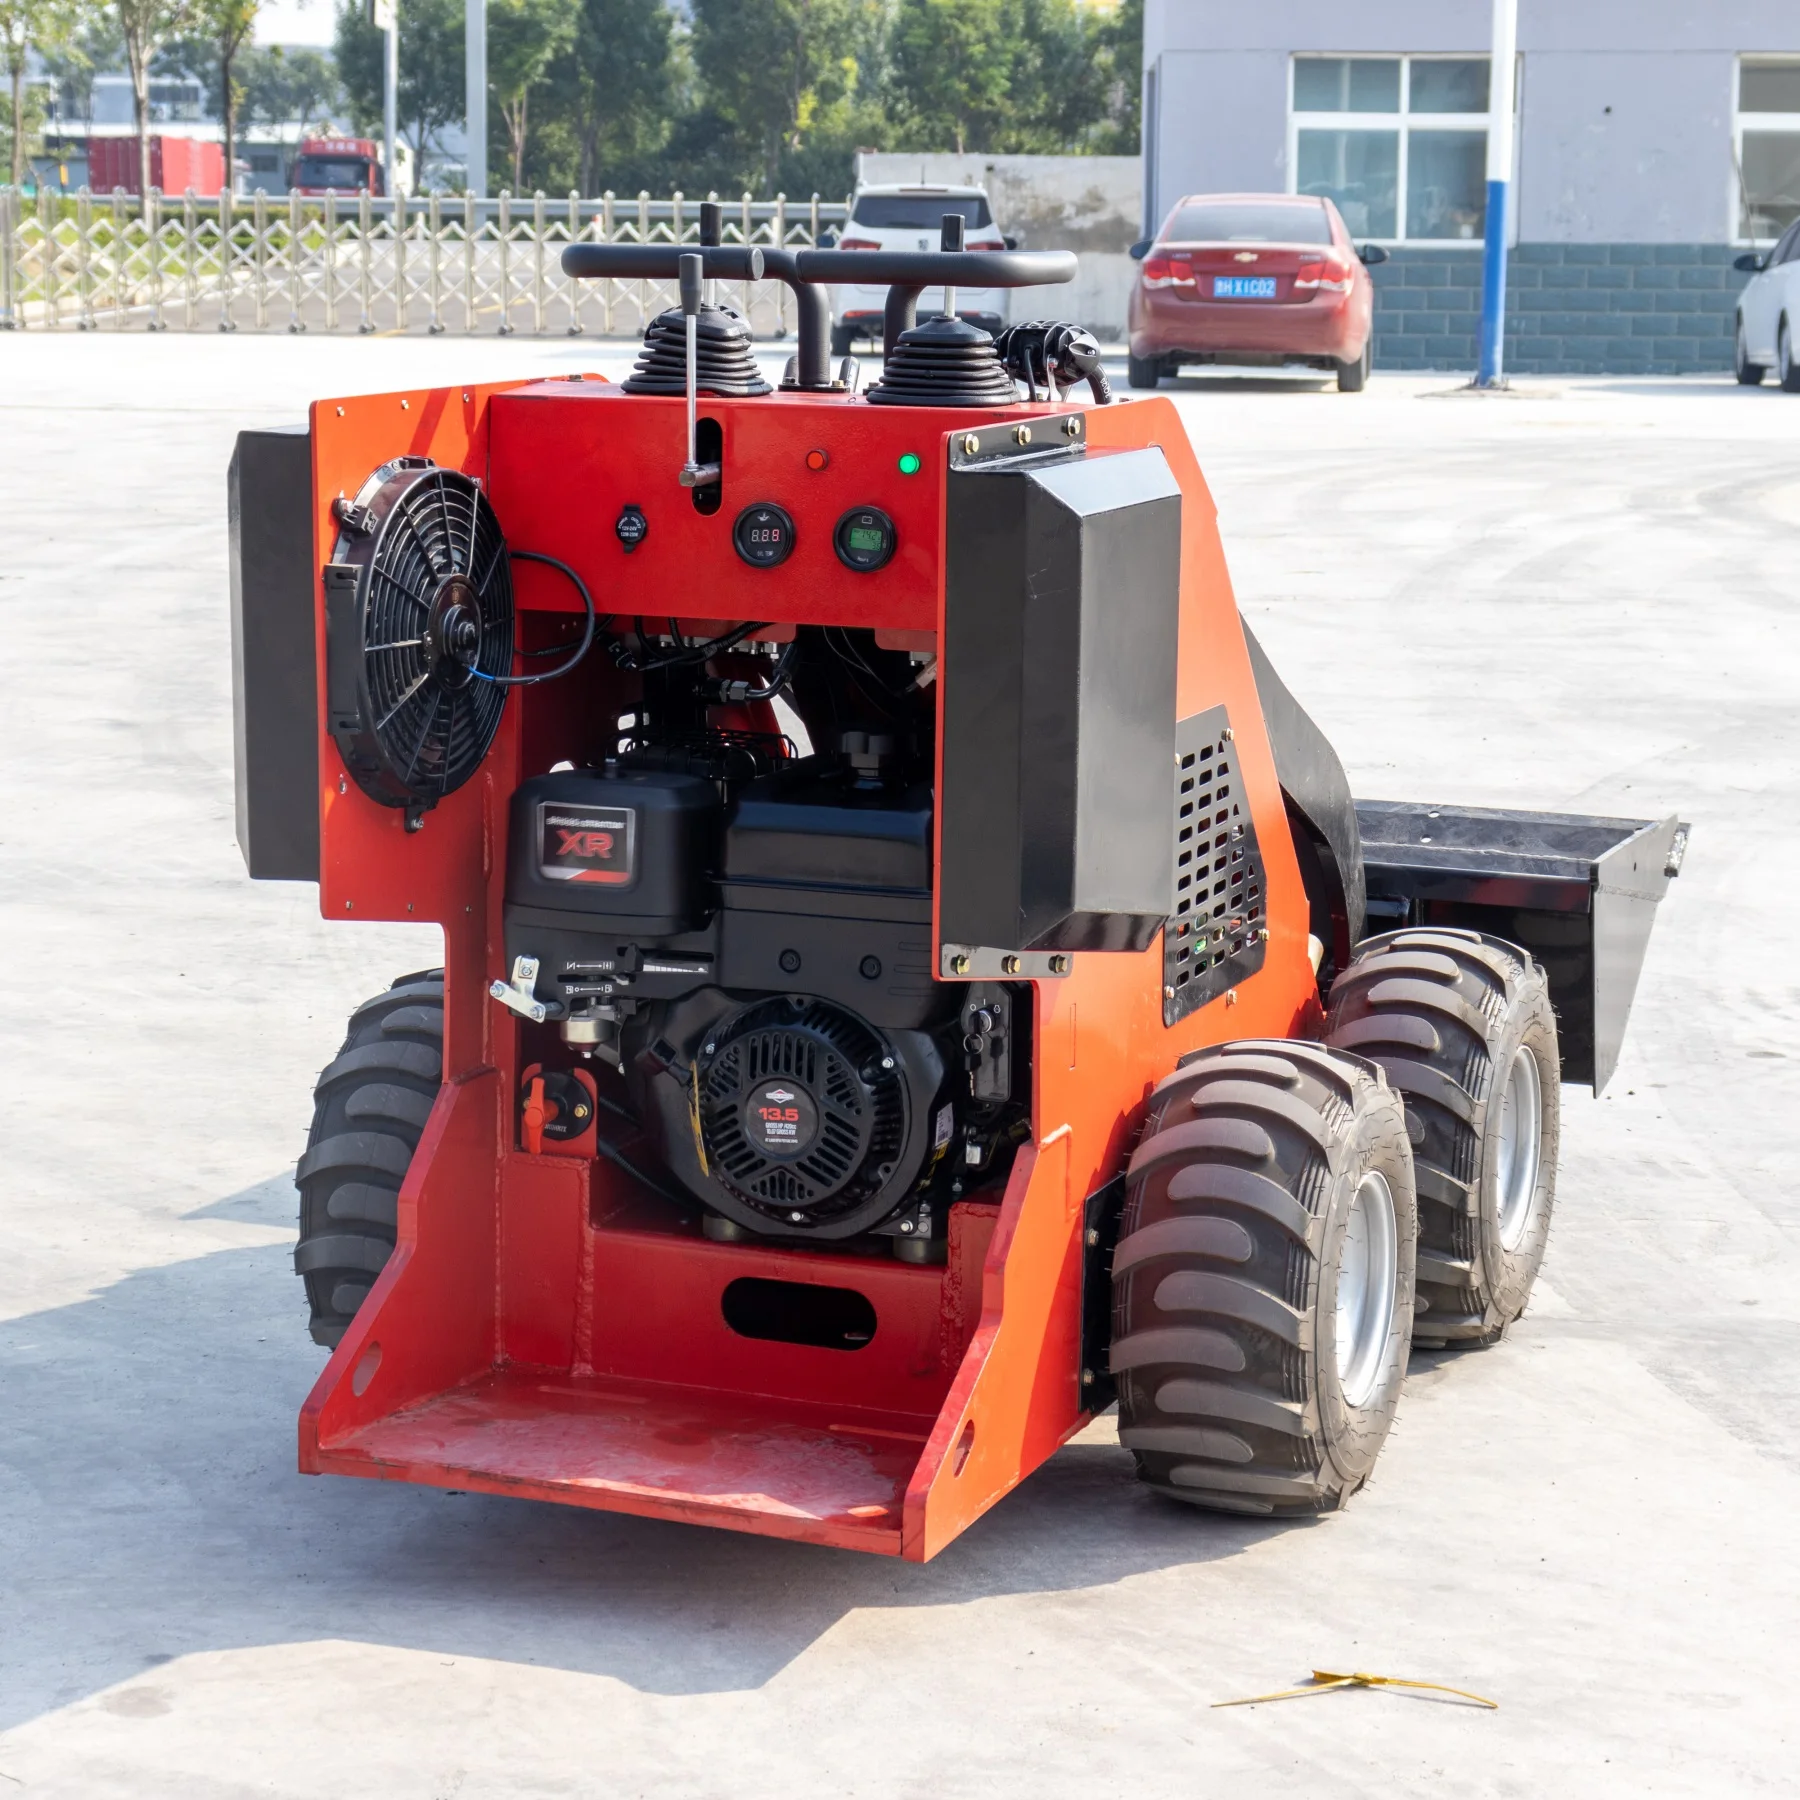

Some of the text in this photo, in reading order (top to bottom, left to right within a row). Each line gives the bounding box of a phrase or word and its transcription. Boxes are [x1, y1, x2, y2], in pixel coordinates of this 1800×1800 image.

[618, 516, 642, 529] POWER OUTLET
[556, 829, 613, 858] XR
[758, 1107, 799, 1121] 13.5
